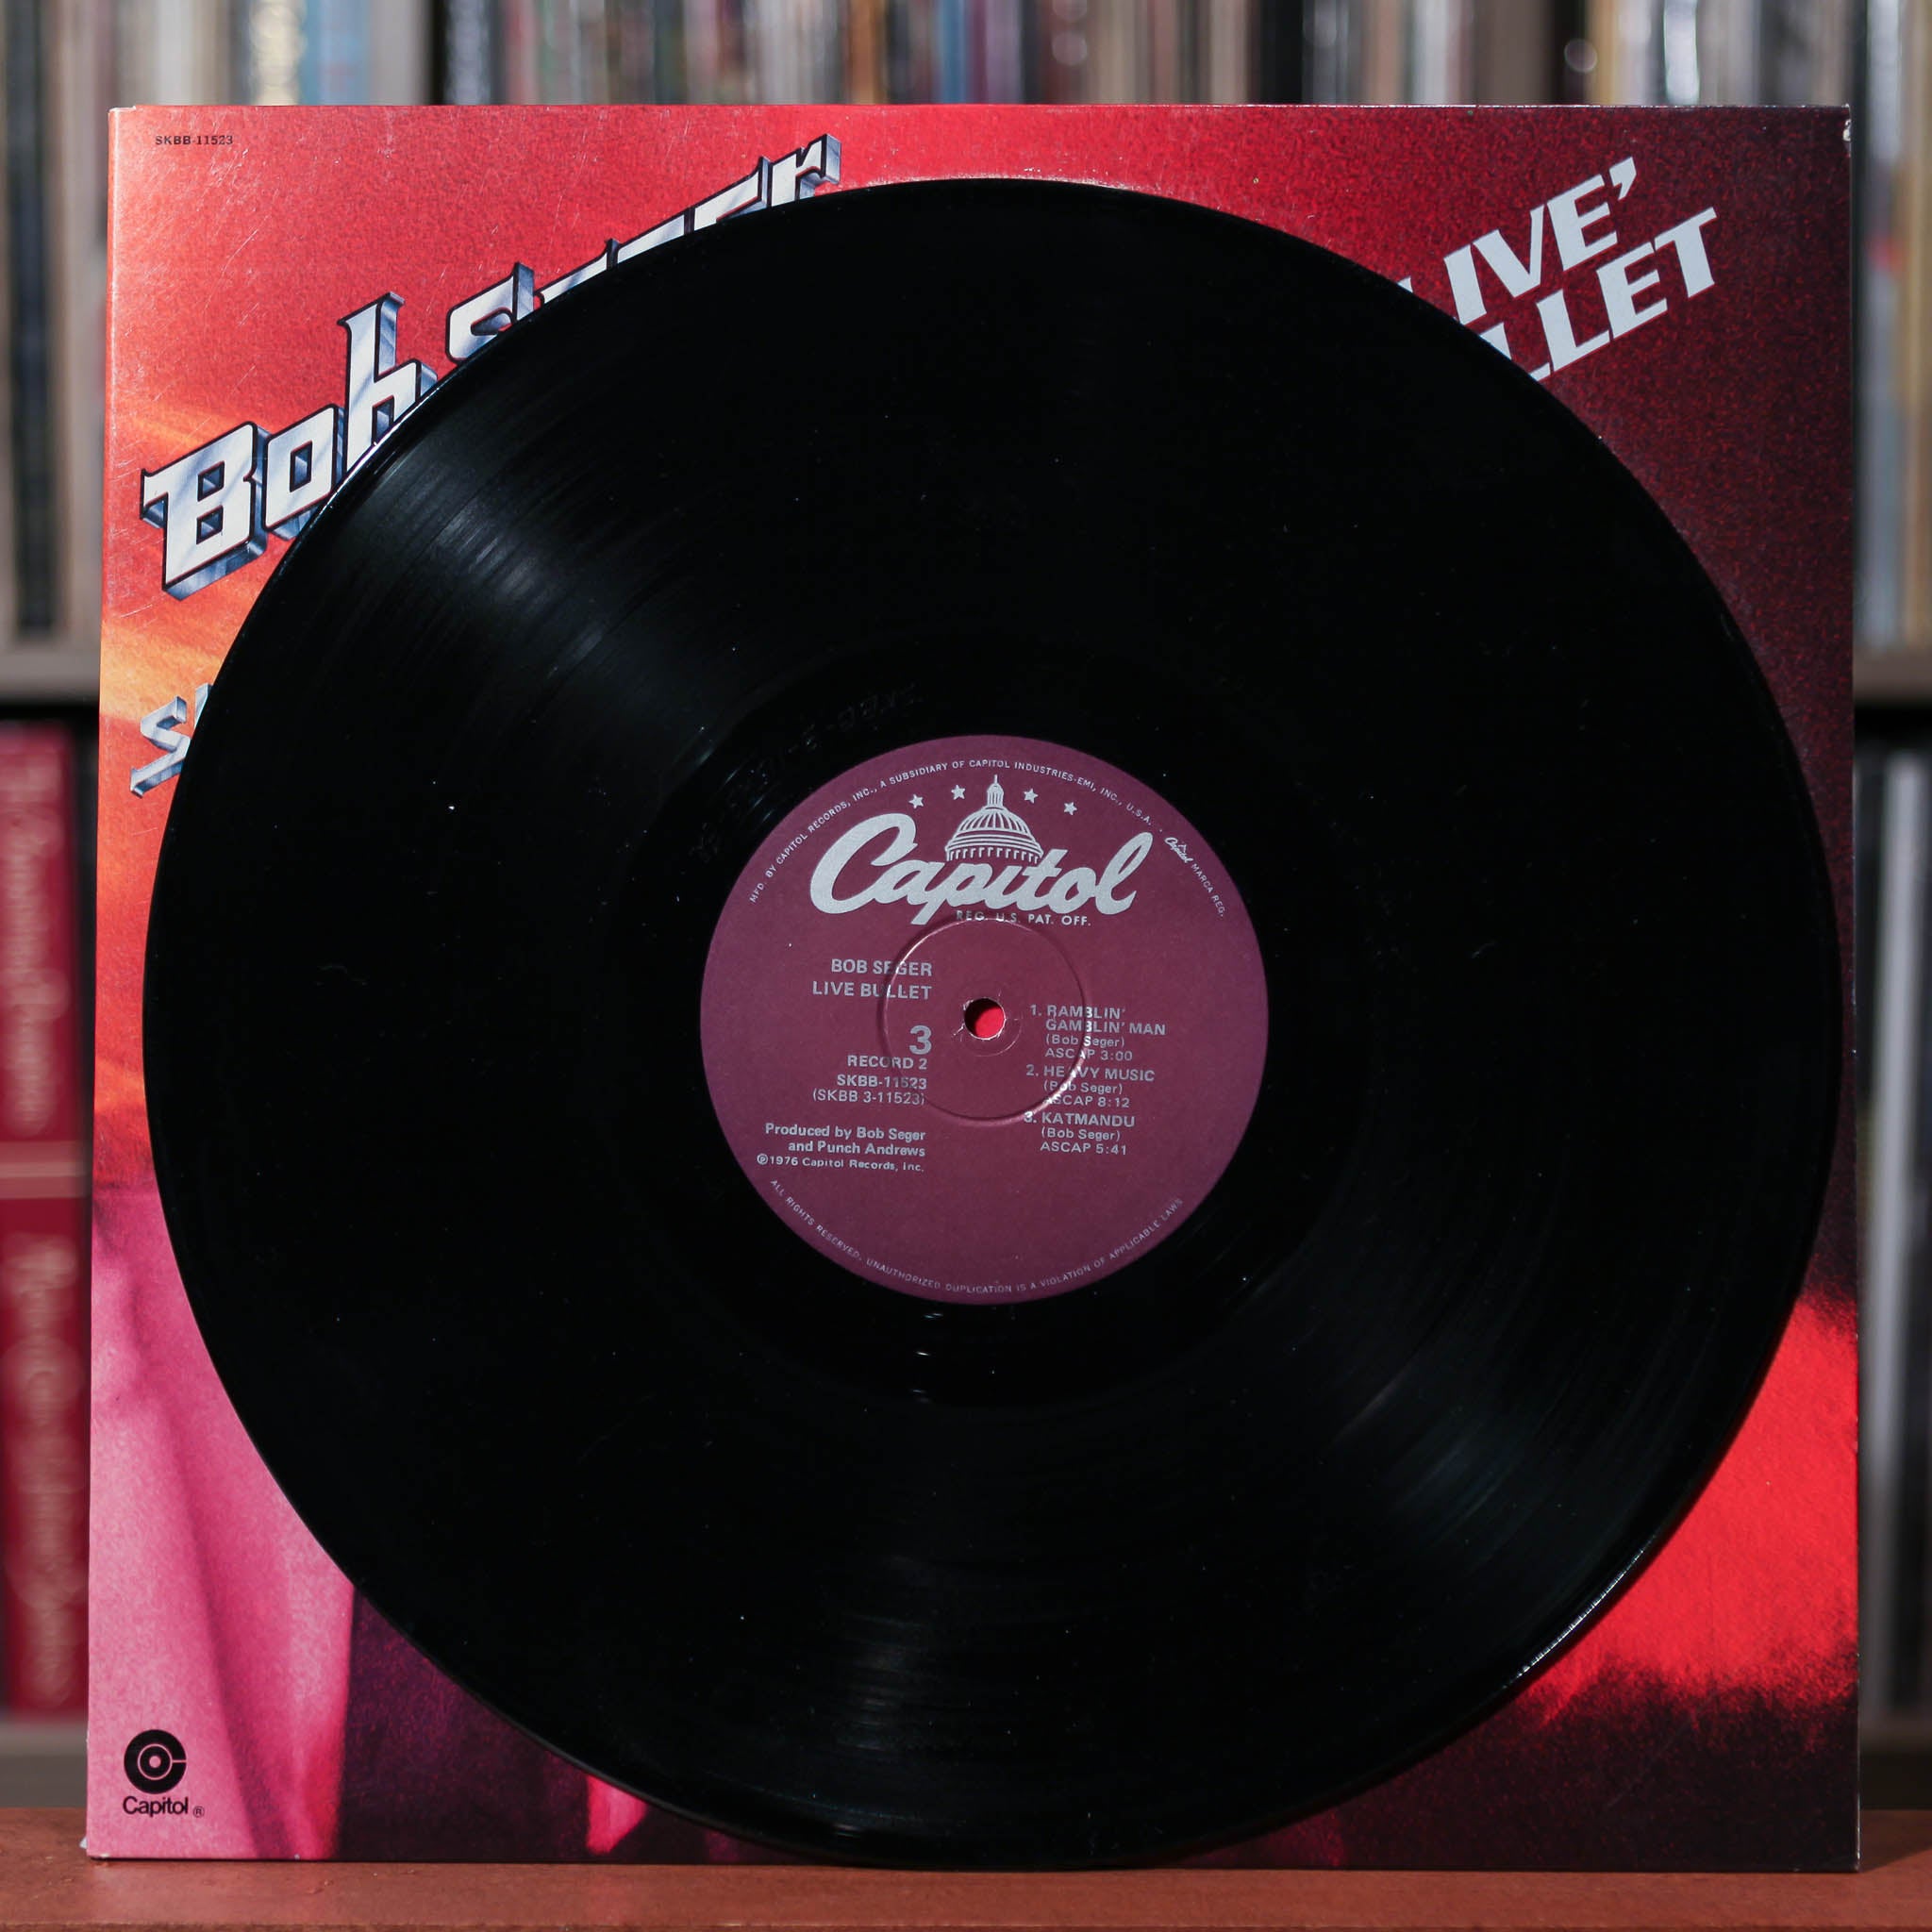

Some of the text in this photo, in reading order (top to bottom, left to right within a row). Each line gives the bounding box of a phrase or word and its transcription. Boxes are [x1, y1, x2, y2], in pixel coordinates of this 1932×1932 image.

[765, 865, 776, 878] BY
[776, 833, 808, 864] CAPITOL
[808, 800, 852, 833] RECORDS,
[852, 786, 878, 802] INC.,
[889, 762, 948, 785] SUBSIDIARY
[952, 759, 965, 770] OF
[969, 758, 1010, 769] CAPITOL
[809, 812, 1154, 927] Capitol
[1191, 863, 1215, 893] MARCA
[1212, 893, 1226, 918] REG.
[956, 909, 990, 921] REG.
[1027, 913, 1055, 925] PAT.
[1060, 915, 1091, 927] OFF.
[831, 958, 932, 976] BOB SEGER
[812, 980, 932, 1000] LIVE BULLET
[1029, 1004, 1042, 1017] 1.
[1129, 1024, 1166, 1036] MAN
[908, 1024, 932, 1056] 3
[1045, 1034, 1125, 1049] (Bob Seger)
[847, 1055, 928, 1070] RECORD 2
[1044, 1048, 1133, 1061] ASCAP 3:00
[1025, 1064, 1156, 1081] 2. HEAVY MUSIC
[837, 1074, 927, 1090] SKBB-11523
[1080, 1082, 1123, 1095] Seger)
[812, 1088, 926, 1105] (SKBB 3-11523)
[1097, 1096, 1130, 1108] 8:12
[1024, 1110, 1135, 1127] 3. KATMANDU
[765, 1123, 926, 1142] Produced by Bob Seger
[1041, 1126, 1121, 1141] (Bob Seger)
[788, 1141, 926, 1157] and Punch Andrews
[1041, 1141, 1127, 1156] ASCAP 5:41
[802, 1157, 844, 1168] Capitol
[849, 1158, 899, 1171] Records,
[903, 1161, 924, 1172] Inc.
[770, 1178, 785, 1196] ALL
[786, 1196, 815, 1225] RIGHTS
[866, 1257, 941, 1289] UNAUTHORIZED
[945, 1283, 1012, 1294] DUPLICATION
[1016, 1283, 1026, 1292] IS
[1040, 1265, 1091, 1289] VIOLATION
[1093, 1257, 1107, 1269] OF
[1108, 1219, 1160, 1260] APPLICABLE
[123, 1796, 189, 1817] Capitol
